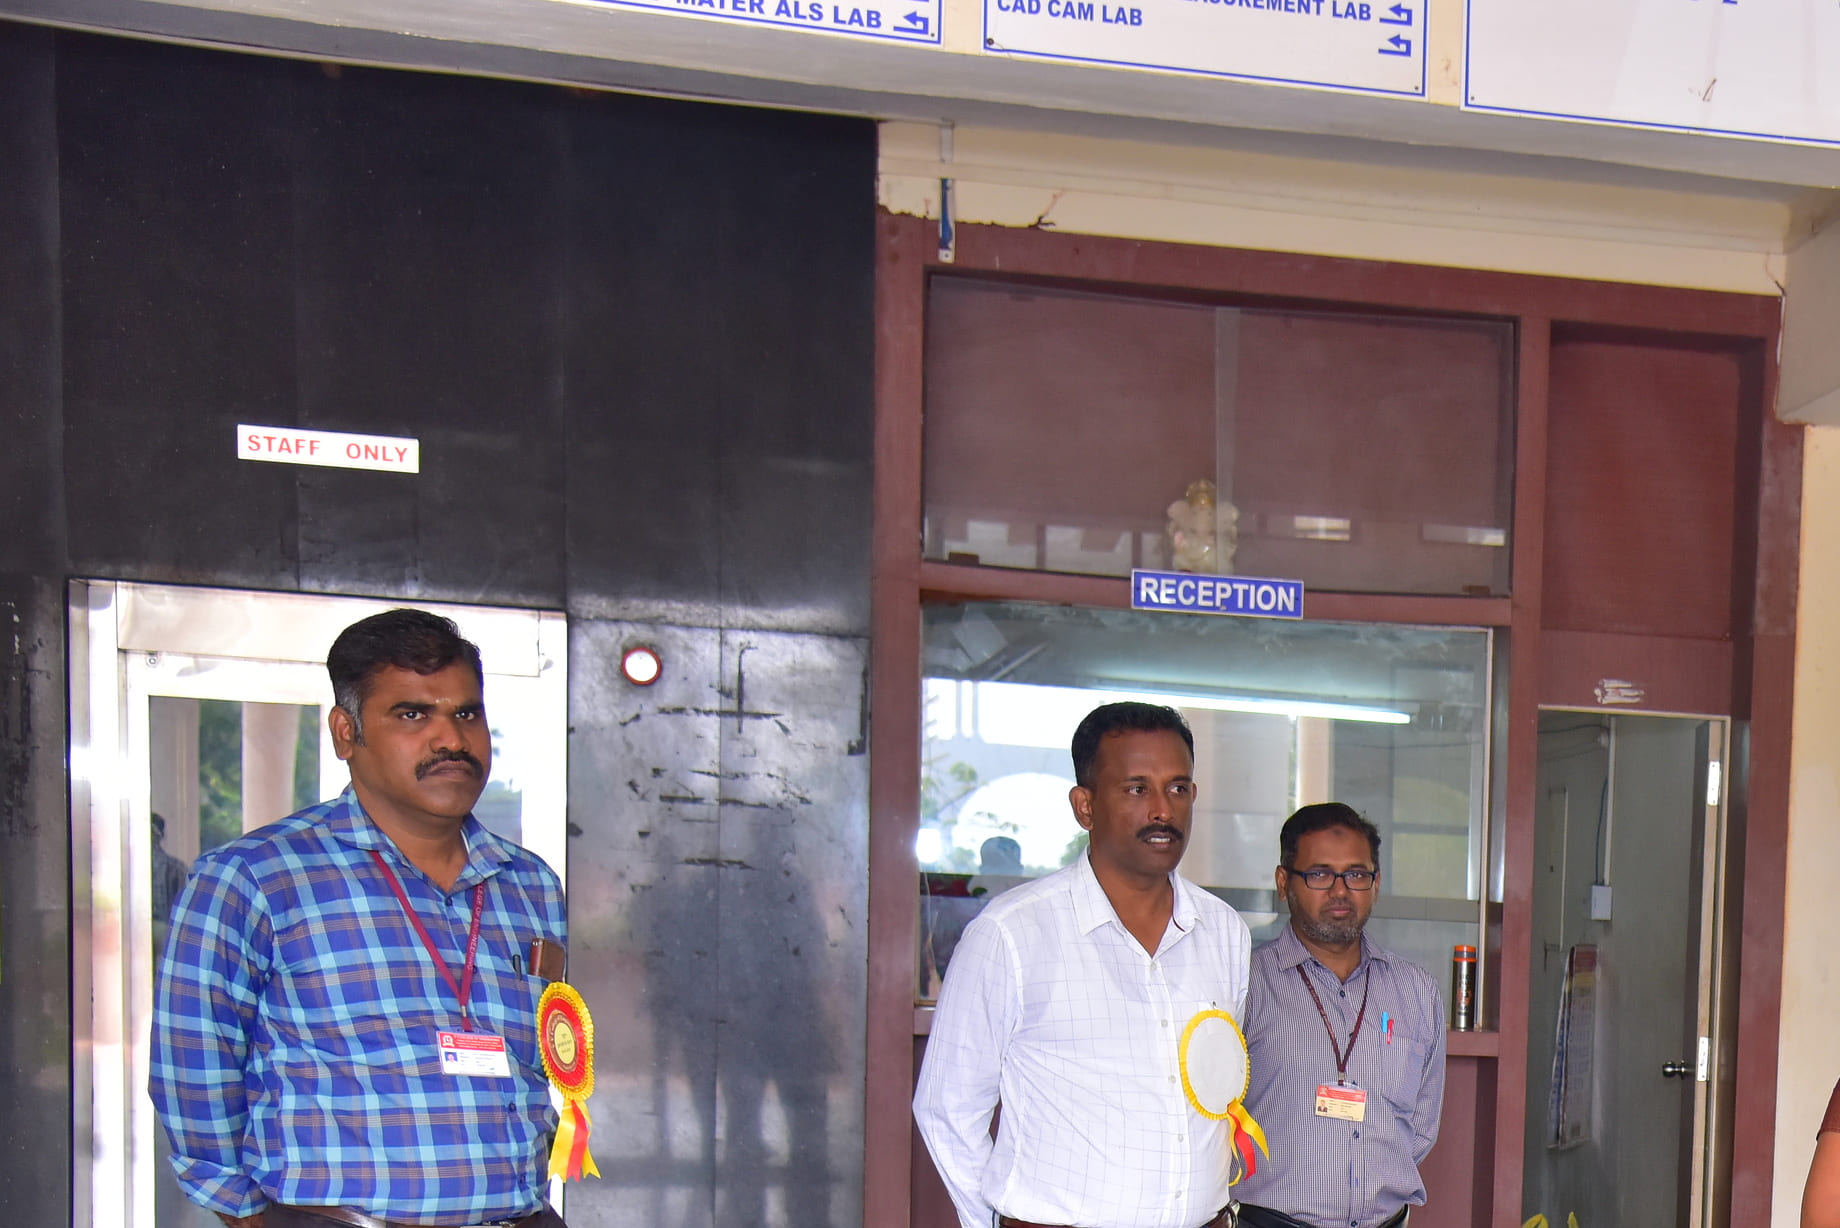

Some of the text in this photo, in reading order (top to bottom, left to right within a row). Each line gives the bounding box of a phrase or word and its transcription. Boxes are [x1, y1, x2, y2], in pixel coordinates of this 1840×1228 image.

[833, 6, 883, 29] LAB
[997, 0, 1143, 27] CAD CAM LAB
[1332, 0, 1372, 22] LAB
[247, 434, 408, 463] STAFF ONLY
[1140, 577, 1295, 612] RECEPTION
